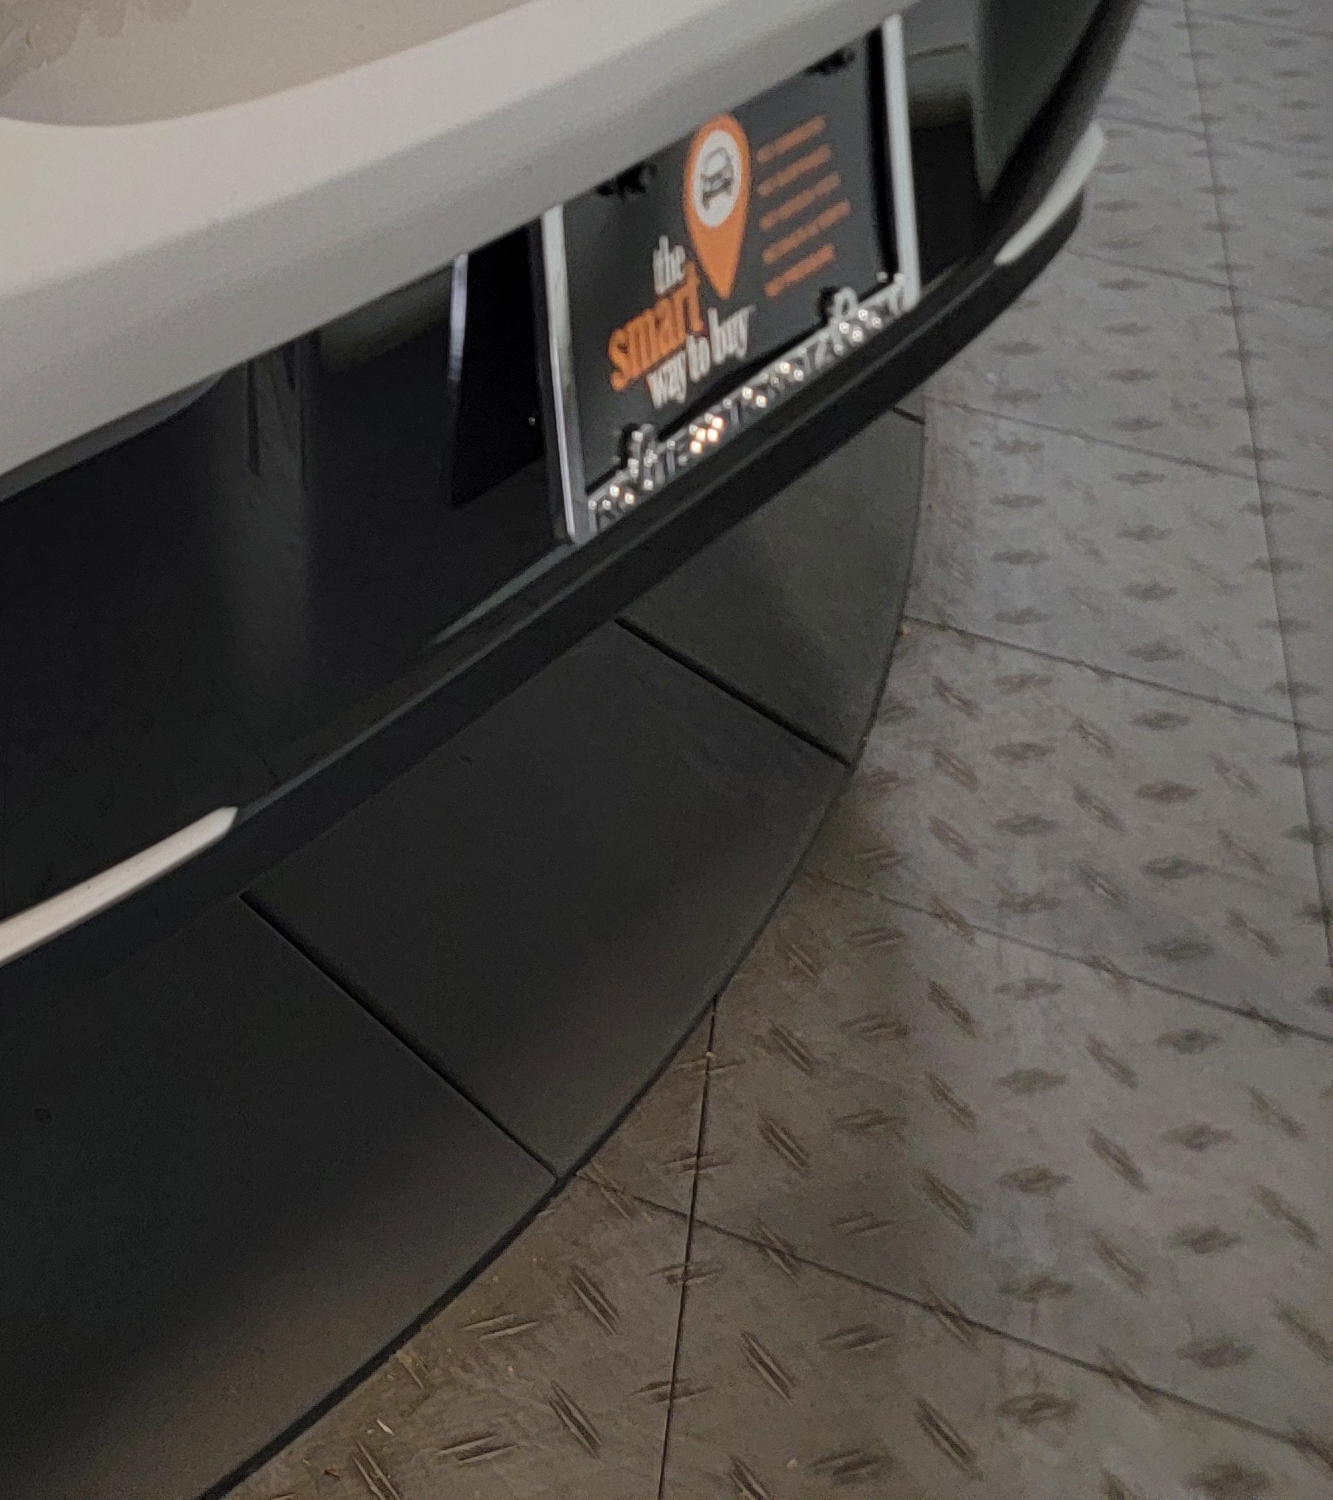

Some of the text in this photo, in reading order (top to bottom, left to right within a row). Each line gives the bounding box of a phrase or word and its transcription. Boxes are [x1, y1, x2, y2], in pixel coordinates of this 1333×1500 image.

[652, 234, 686, 295] the
[607, 259, 704, 393] smart
[645, 350, 688, 409] way
[685, 333, 712, 383] to
[706, 304, 758, 365] buy
